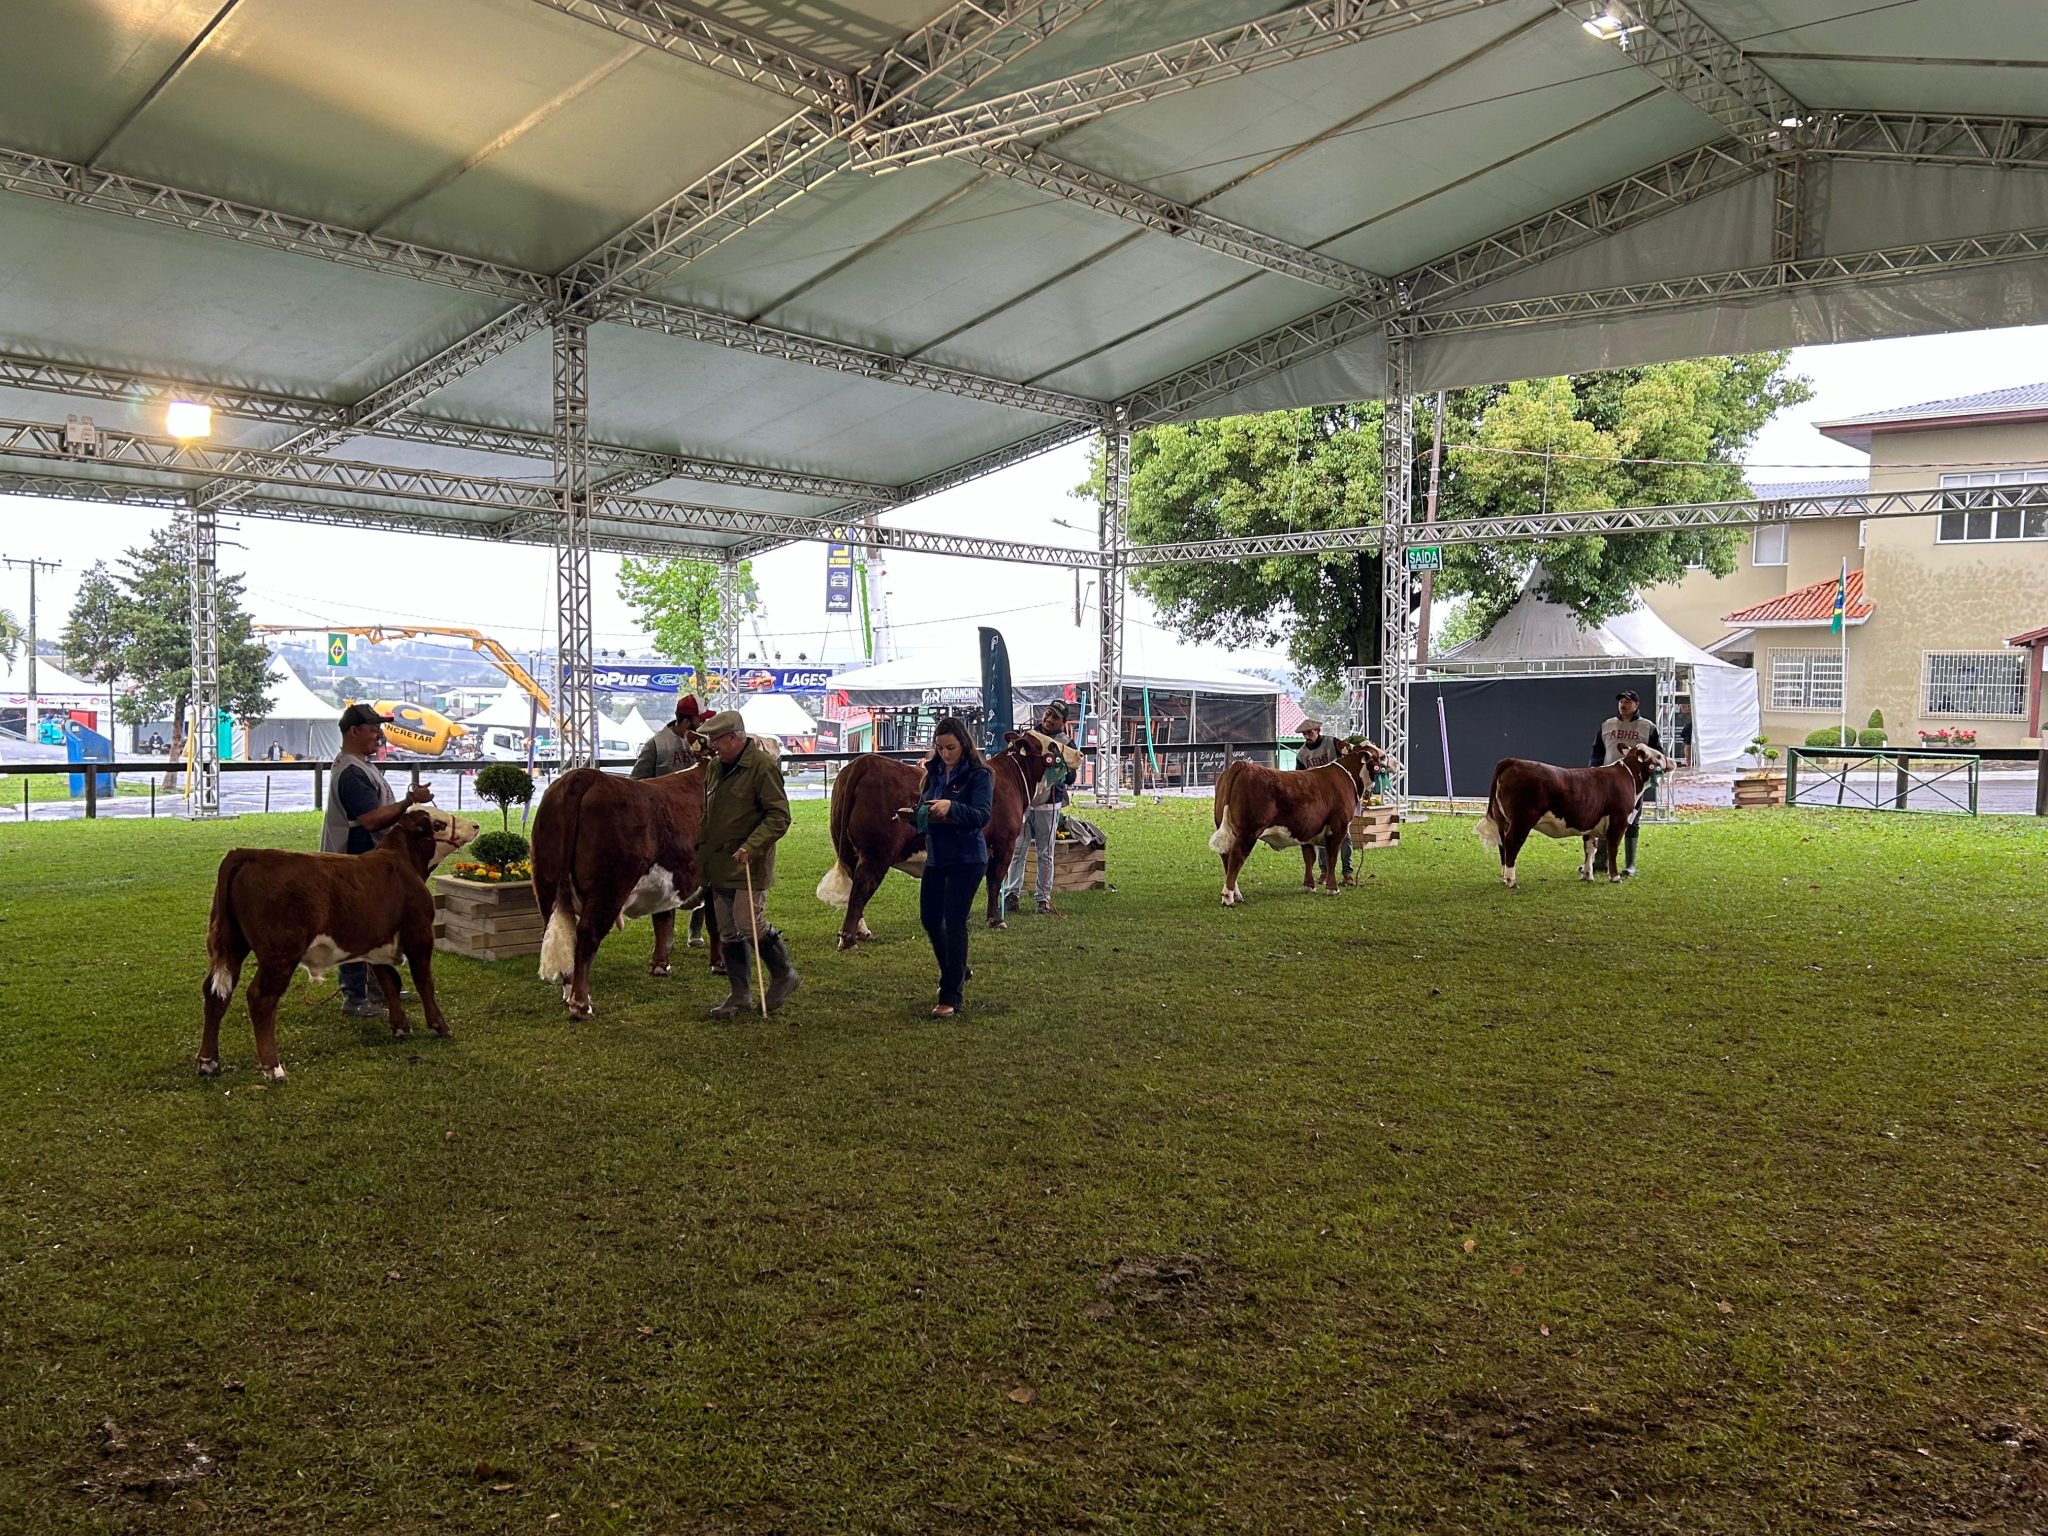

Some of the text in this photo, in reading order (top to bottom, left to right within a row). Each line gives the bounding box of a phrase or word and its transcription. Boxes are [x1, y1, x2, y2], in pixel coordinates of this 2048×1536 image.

[1410, 550, 1438, 563] SAÍDA
[783, 673, 827, 686] LAGES
[384, 723, 432, 743] NCRETAR
[1610, 730, 1639, 739] ABHB
